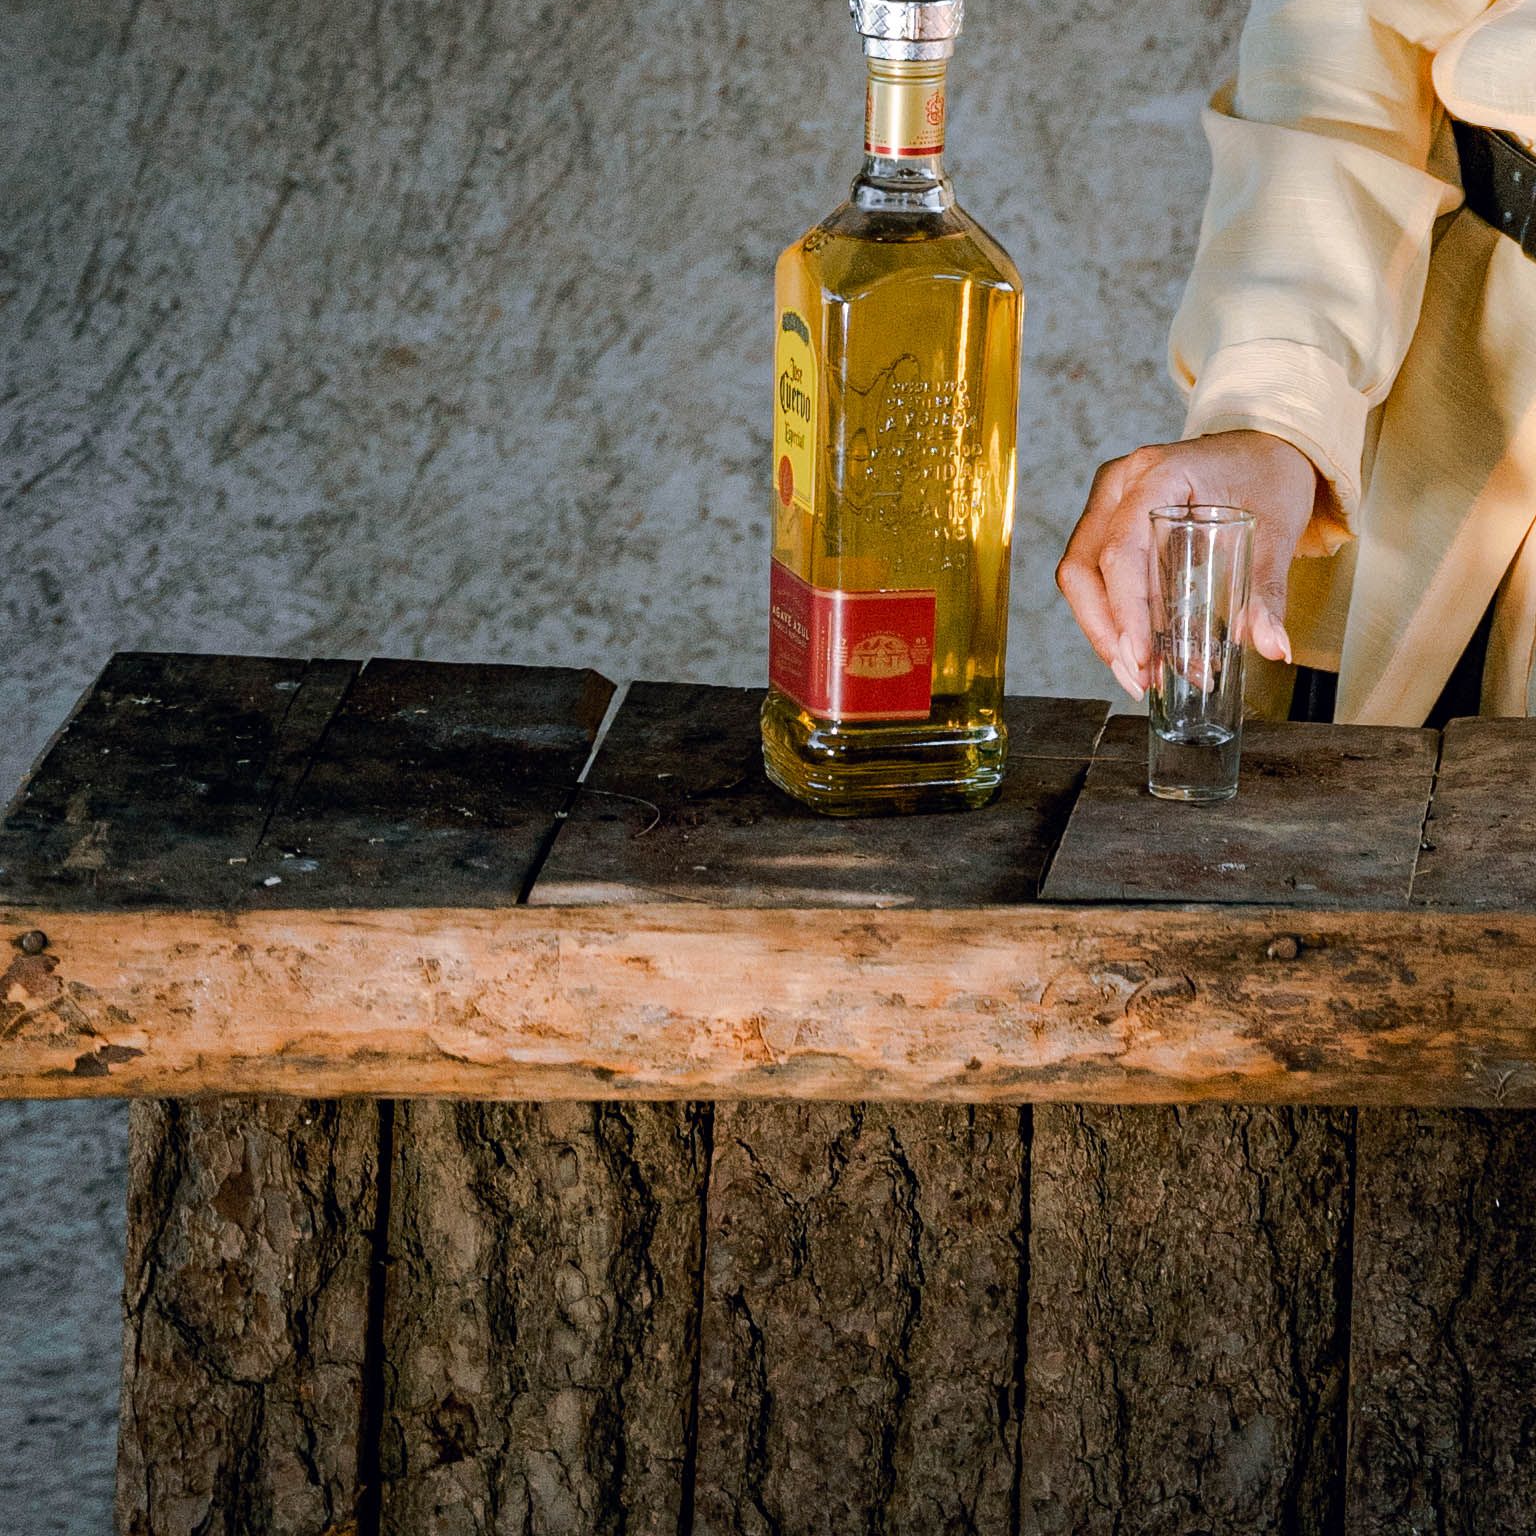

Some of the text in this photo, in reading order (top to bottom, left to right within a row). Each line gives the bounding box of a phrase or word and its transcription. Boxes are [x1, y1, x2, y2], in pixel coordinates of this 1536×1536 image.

[779, 370, 811, 423] Cuervo
[772, 603, 793, 628] AGAVE
[792, 620, 811, 641] AZUL
